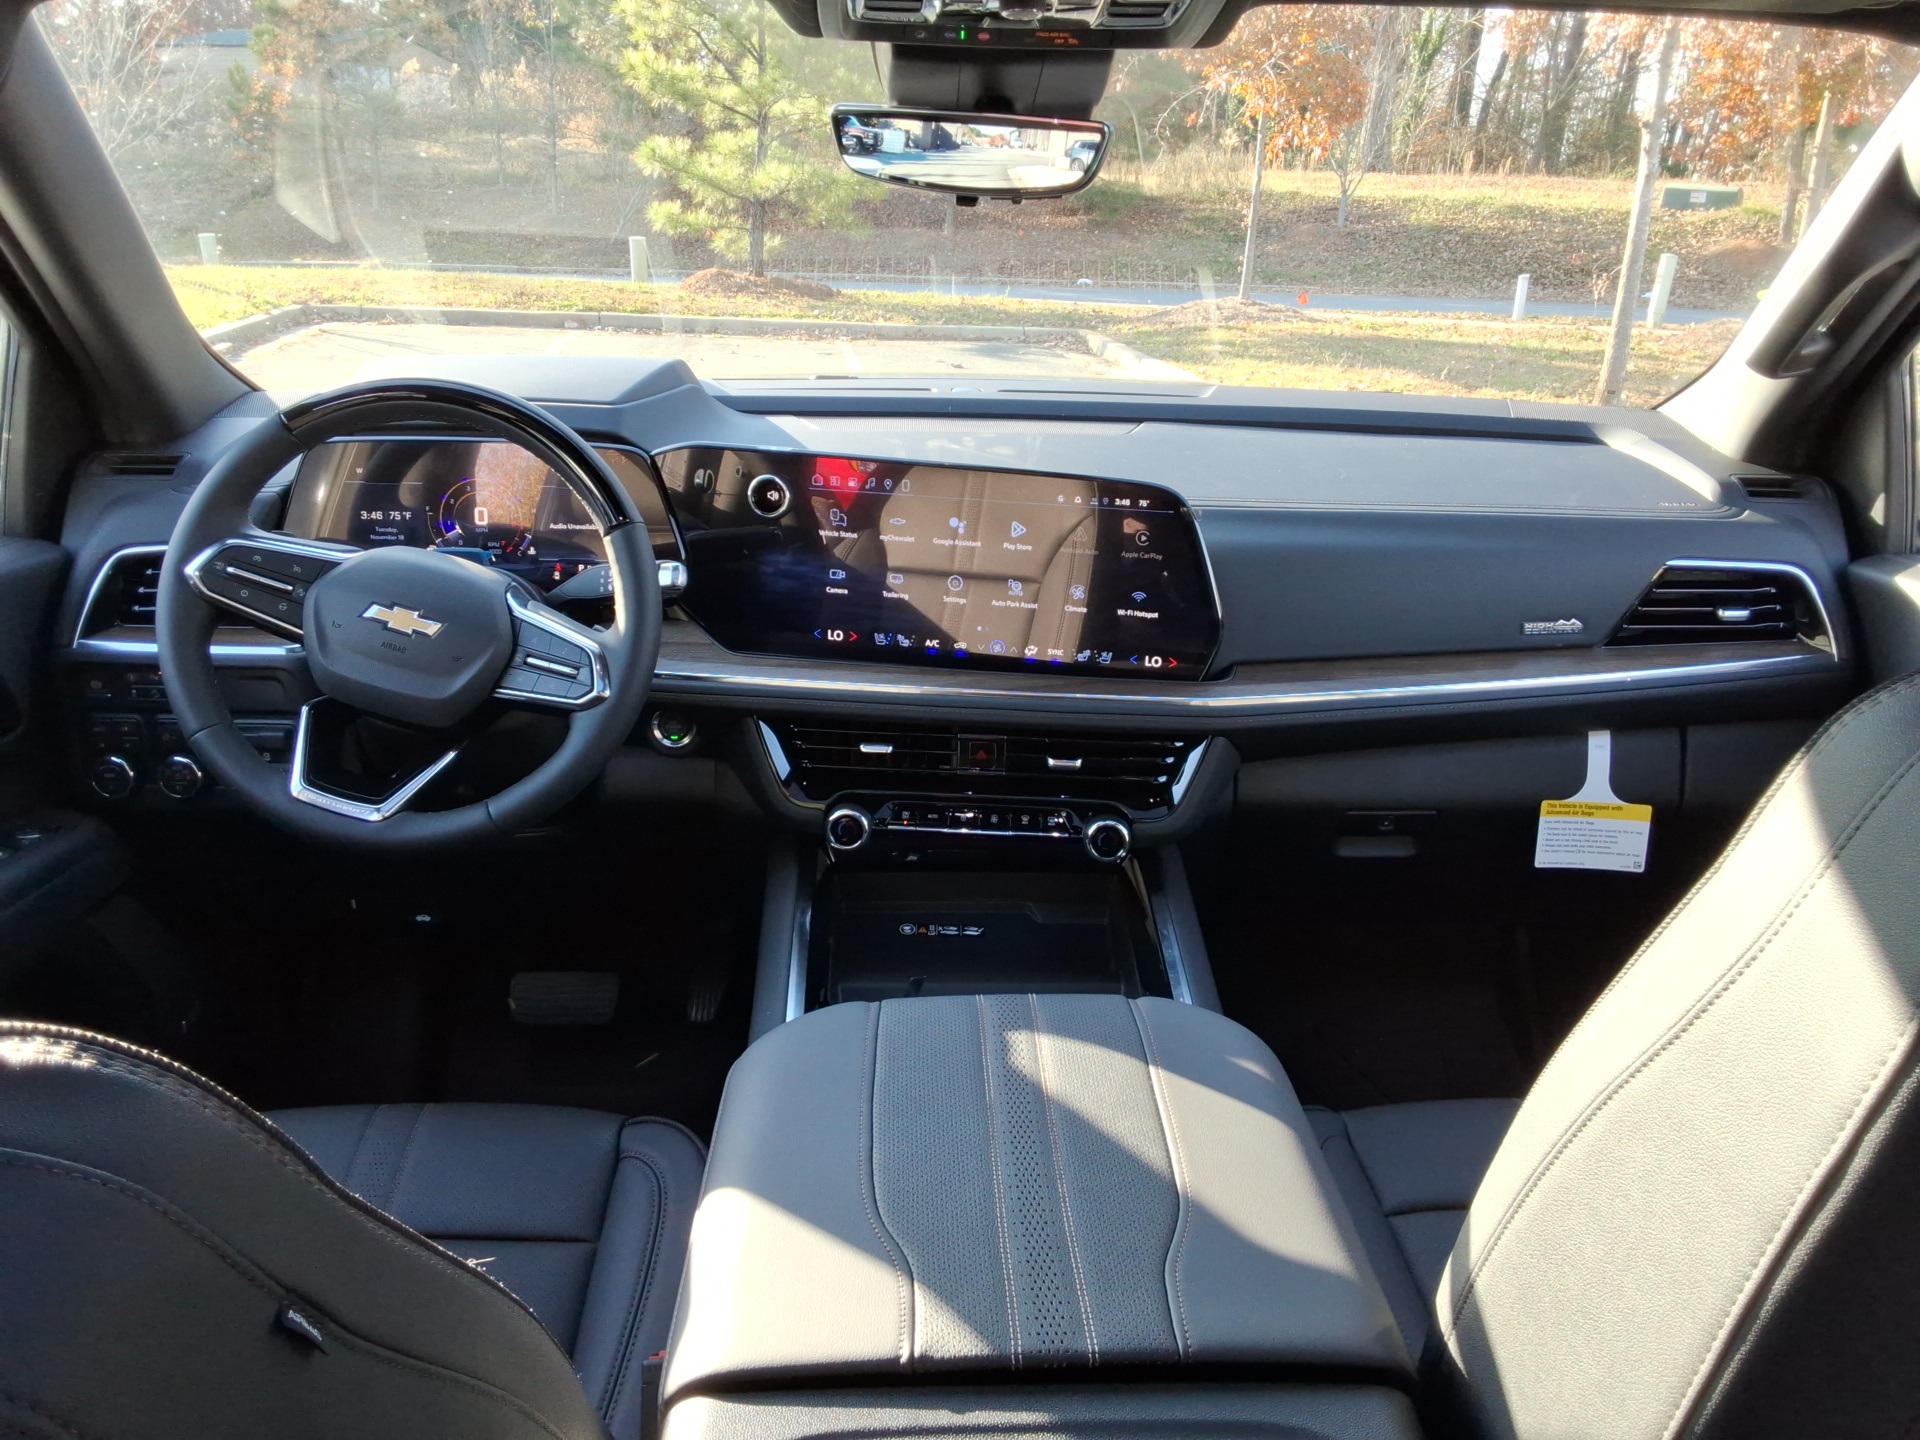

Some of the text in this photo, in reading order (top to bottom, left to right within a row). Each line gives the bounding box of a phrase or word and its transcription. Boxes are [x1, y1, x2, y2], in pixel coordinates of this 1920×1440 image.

[360, 511, 383, 520] 3:46
[389, 511, 401, 519] 75
[474, 507, 488, 525] 0
[818, 529, 858, 539] Vehicle Status
[879, 535, 915, 543] myChevrolet
[933, 537, 981, 547] Google Assistant
[1003, 542, 1032, 551] Play Store
[1121, 551, 1163, 561] Apple CarPlay
[826, 586, 848, 594] Camera
[882, 590, 909, 600] Trailering
[943, 595, 967, 604] Settings
[1020, 601, 1038, 609] Assist
[1065, 605, 1087, 613] Climate
[1117, 609, 1159, 619] Wi-Fi Hotspot
[827, 629, 843, 641] LO
[925, 639, 940, 647] A/C
[1047, 648, 1064, 656] SYNC
[1144, 656, 1162, 667] LO
